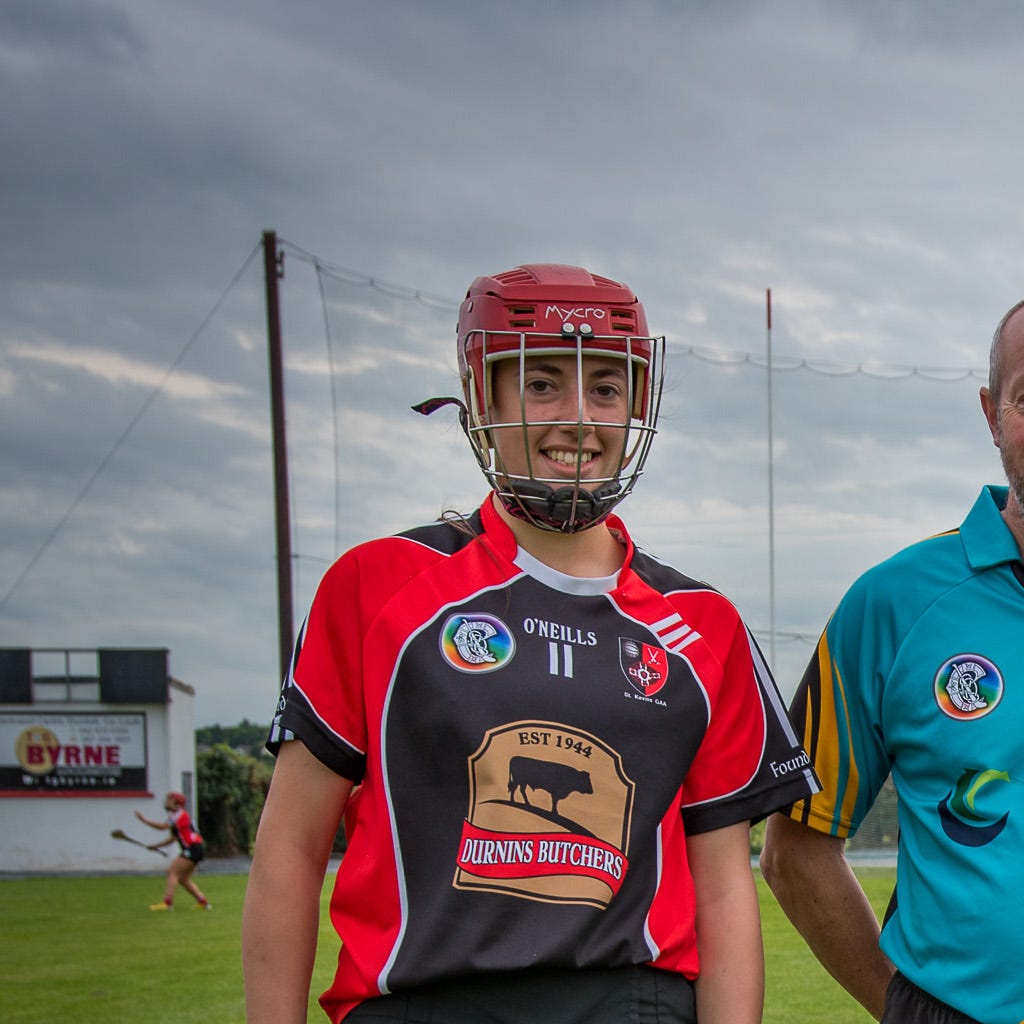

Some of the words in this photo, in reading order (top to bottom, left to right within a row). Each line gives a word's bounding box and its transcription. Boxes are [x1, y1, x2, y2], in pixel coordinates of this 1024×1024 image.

[523, 617, 597, 646] O'NEILLS
[549, 641, 573, 678] 11
[27, 745, 120, 766] BYRNE
[518, 732, 551, 746] EST
[555, 735, 593, 759] 1944
[461, 838, 533, 864] DURNINS
[537, 841, 623, 880] BUTCHERS
